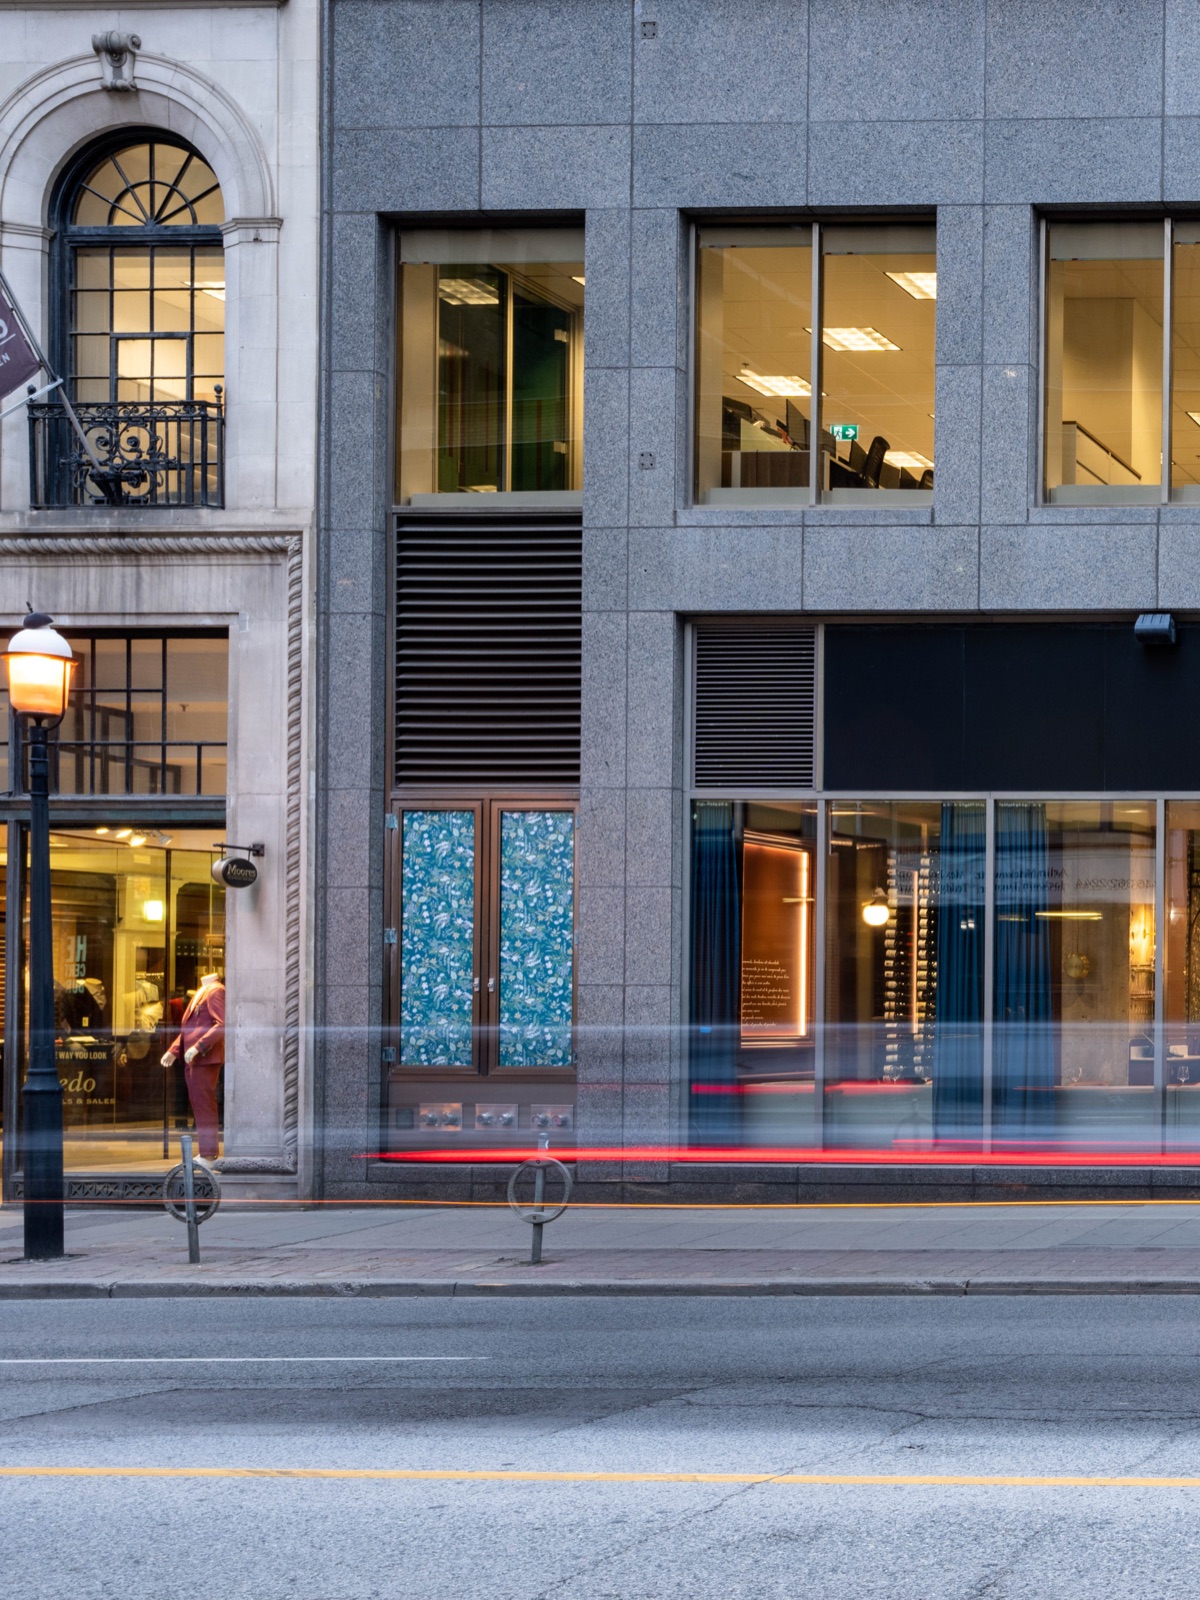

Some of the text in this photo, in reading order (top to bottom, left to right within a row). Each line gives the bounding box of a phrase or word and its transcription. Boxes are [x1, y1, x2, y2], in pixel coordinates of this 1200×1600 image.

[227, 864, 257, 878] Moores
[59, 1051, 74, 1060] WAY
[74, 1051, 88, 1060] YOU
[89, 1051, 107, 1060] LOOK
[59, 1070, 96, 1093] edo
